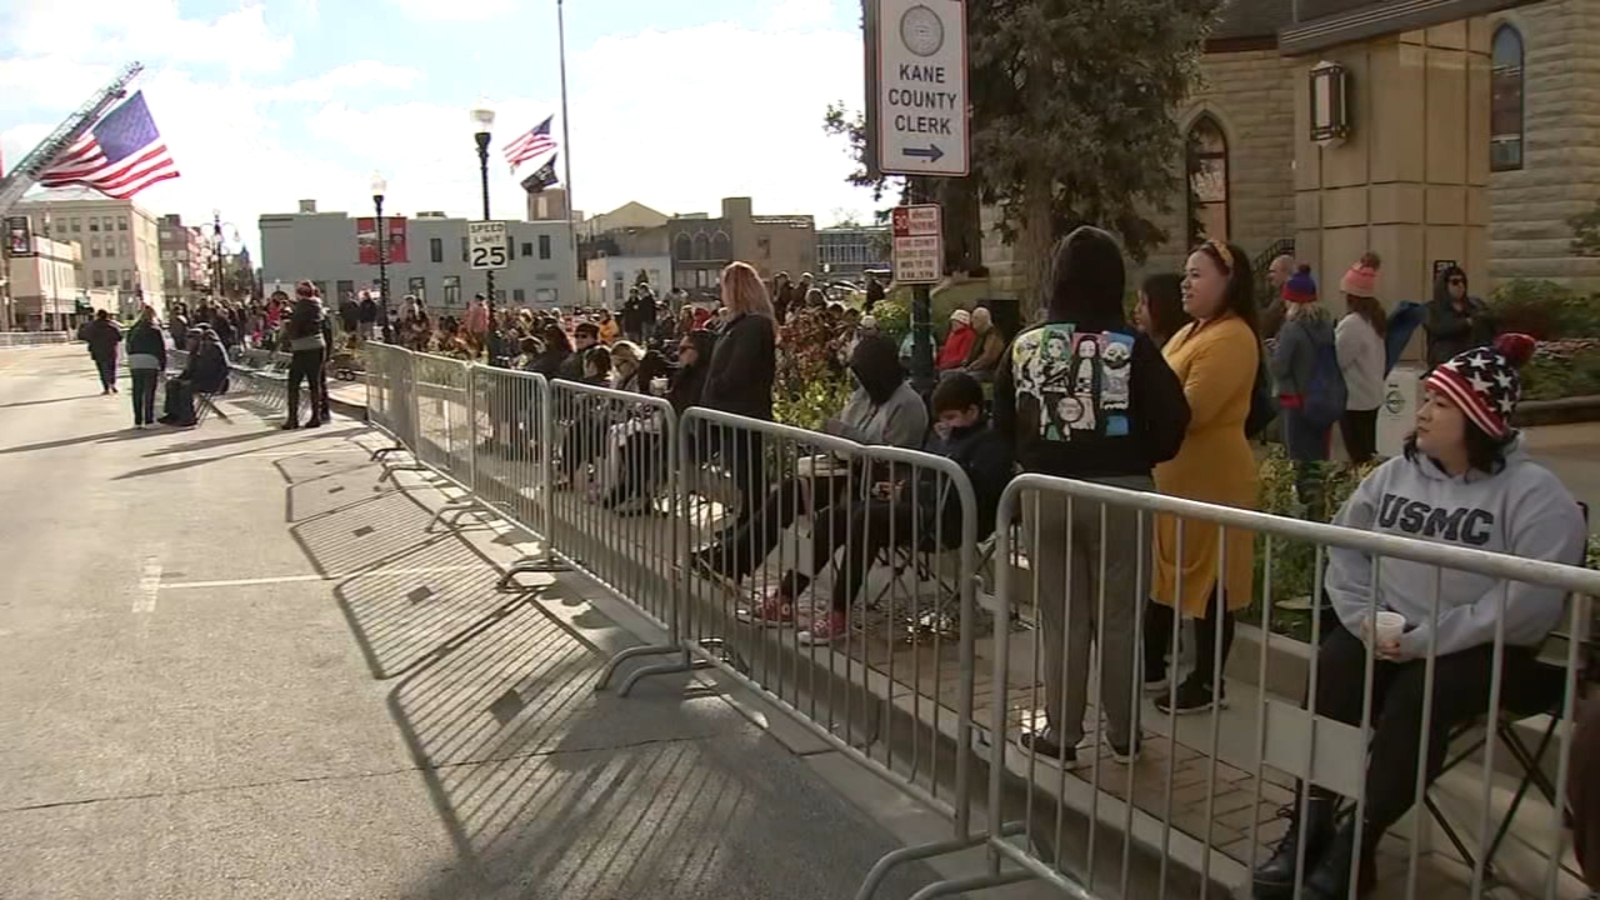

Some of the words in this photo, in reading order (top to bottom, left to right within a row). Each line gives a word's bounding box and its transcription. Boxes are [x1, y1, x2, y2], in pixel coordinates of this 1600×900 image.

[899, 64, 945, 83] KANE
[888, 88, 957, 110] COUNTY
[894, 114, 952, 135] CLERK
[471, 224, 504, 233] SPEED
[474, 234, 501, 244] LIMIT
[473, 247, 505, 267] 25
[1379, 492, 1494, 546] USMC
